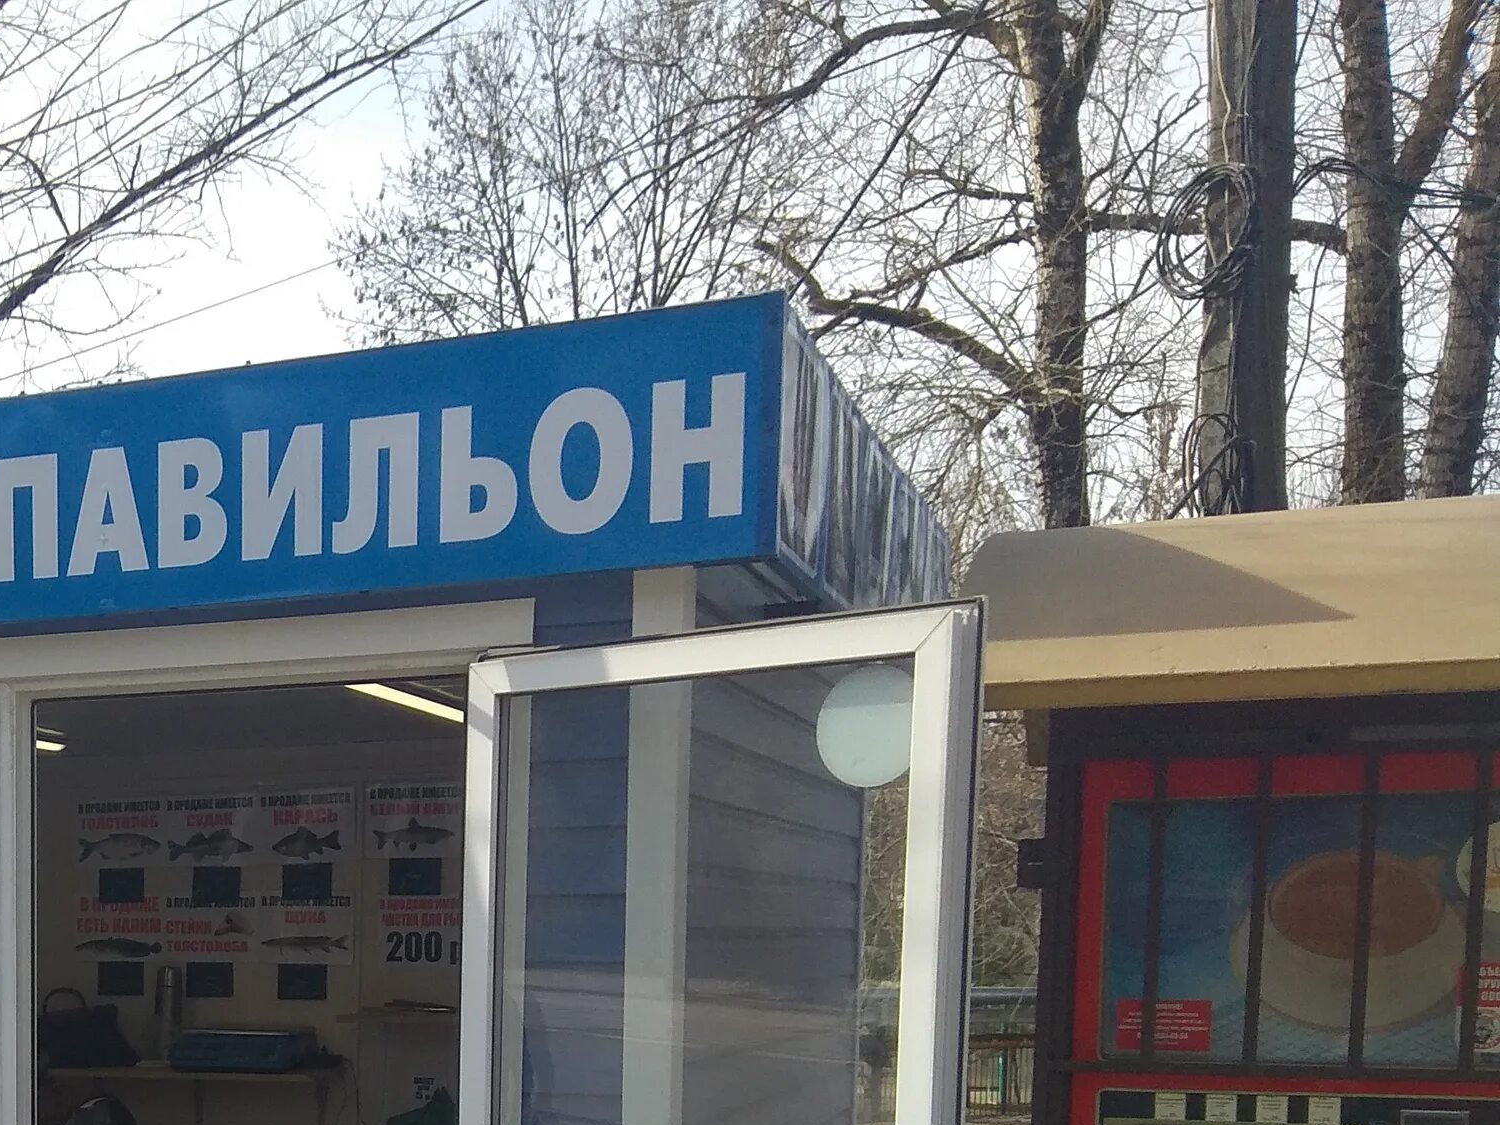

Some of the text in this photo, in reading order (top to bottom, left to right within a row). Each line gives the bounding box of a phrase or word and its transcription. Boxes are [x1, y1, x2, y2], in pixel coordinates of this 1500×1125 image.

[76, 917, 109, 933] ЕСТЬ
[165, 918, 212, 934] СТЕЙКИ
[165, 939, 248, 952] ТОЛСТОЛОБА
[386, 931, 443, 963] 200
